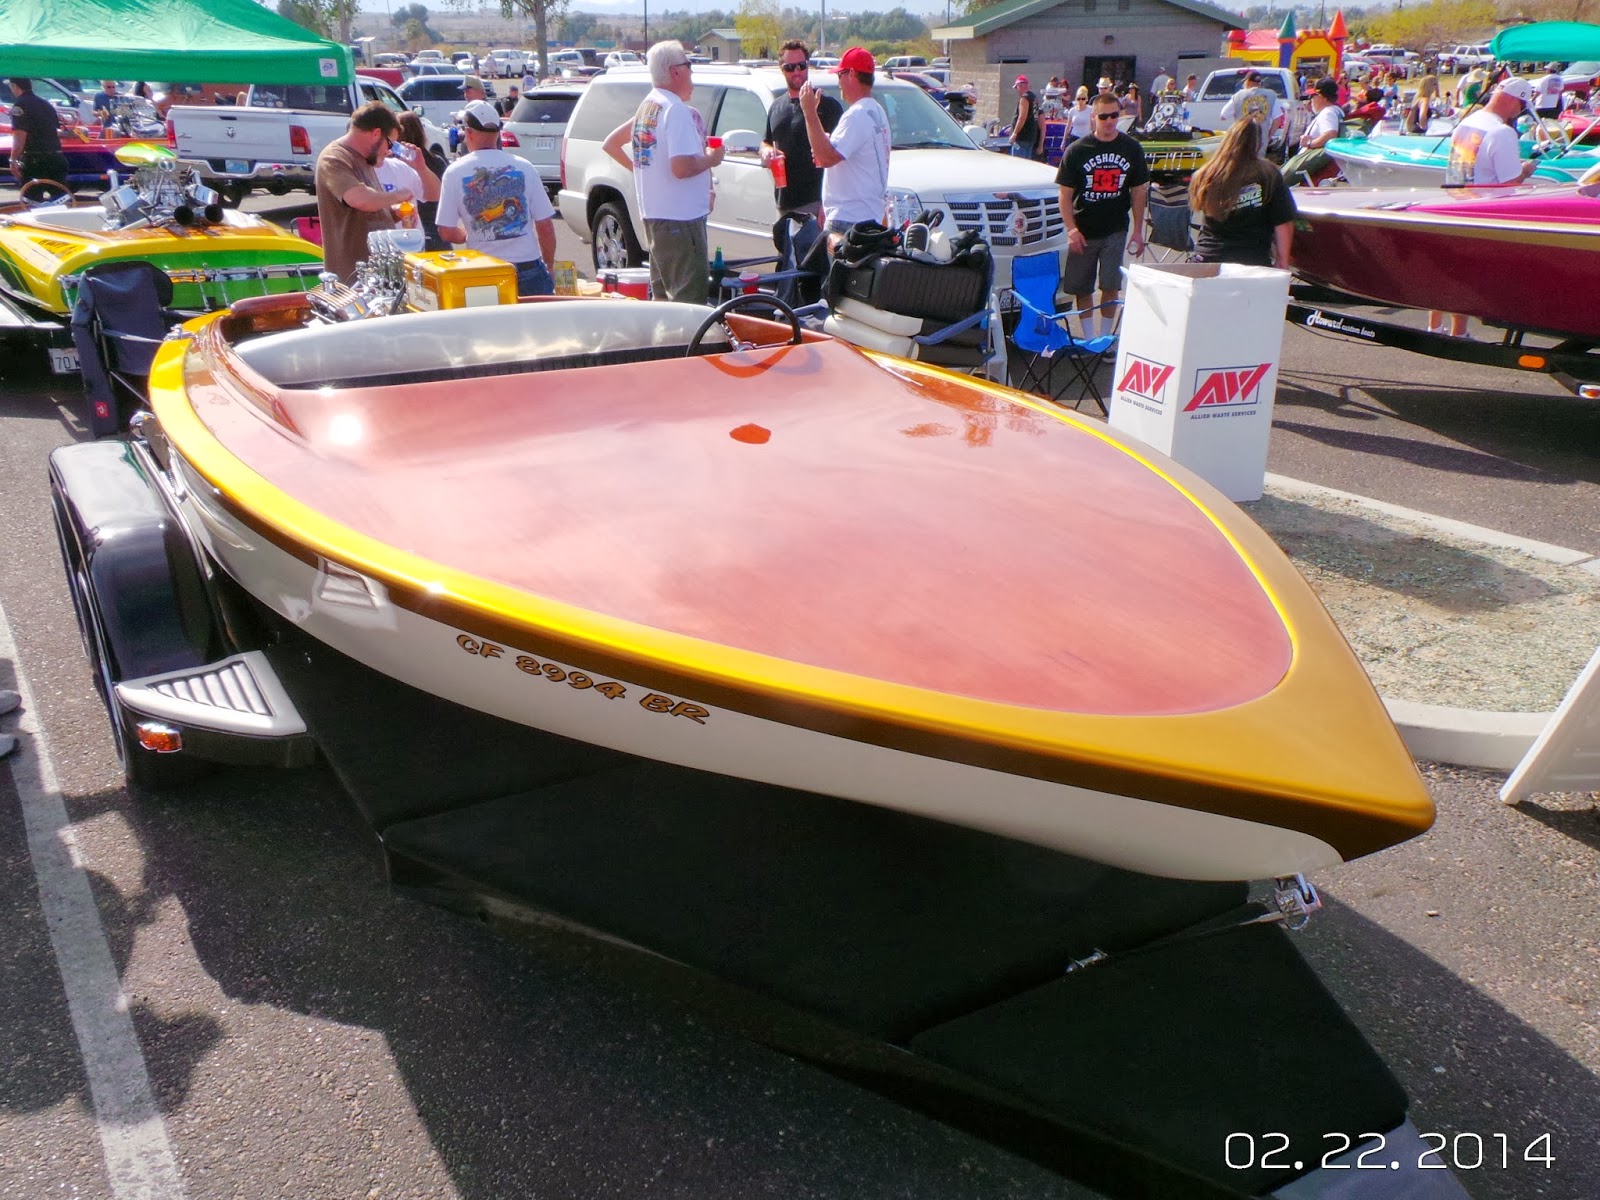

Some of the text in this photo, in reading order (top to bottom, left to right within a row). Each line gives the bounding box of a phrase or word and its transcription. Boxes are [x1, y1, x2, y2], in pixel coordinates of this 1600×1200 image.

[1083, 153, 1131, 172] DCSHOECO
[1306, 310, 1344, 329] Howard
[1133, 401, 1145, 409] WASTE
[1144, 405, 1163, 416] SERVICES
[456, 633, 711, 725] CF 8994 BR
